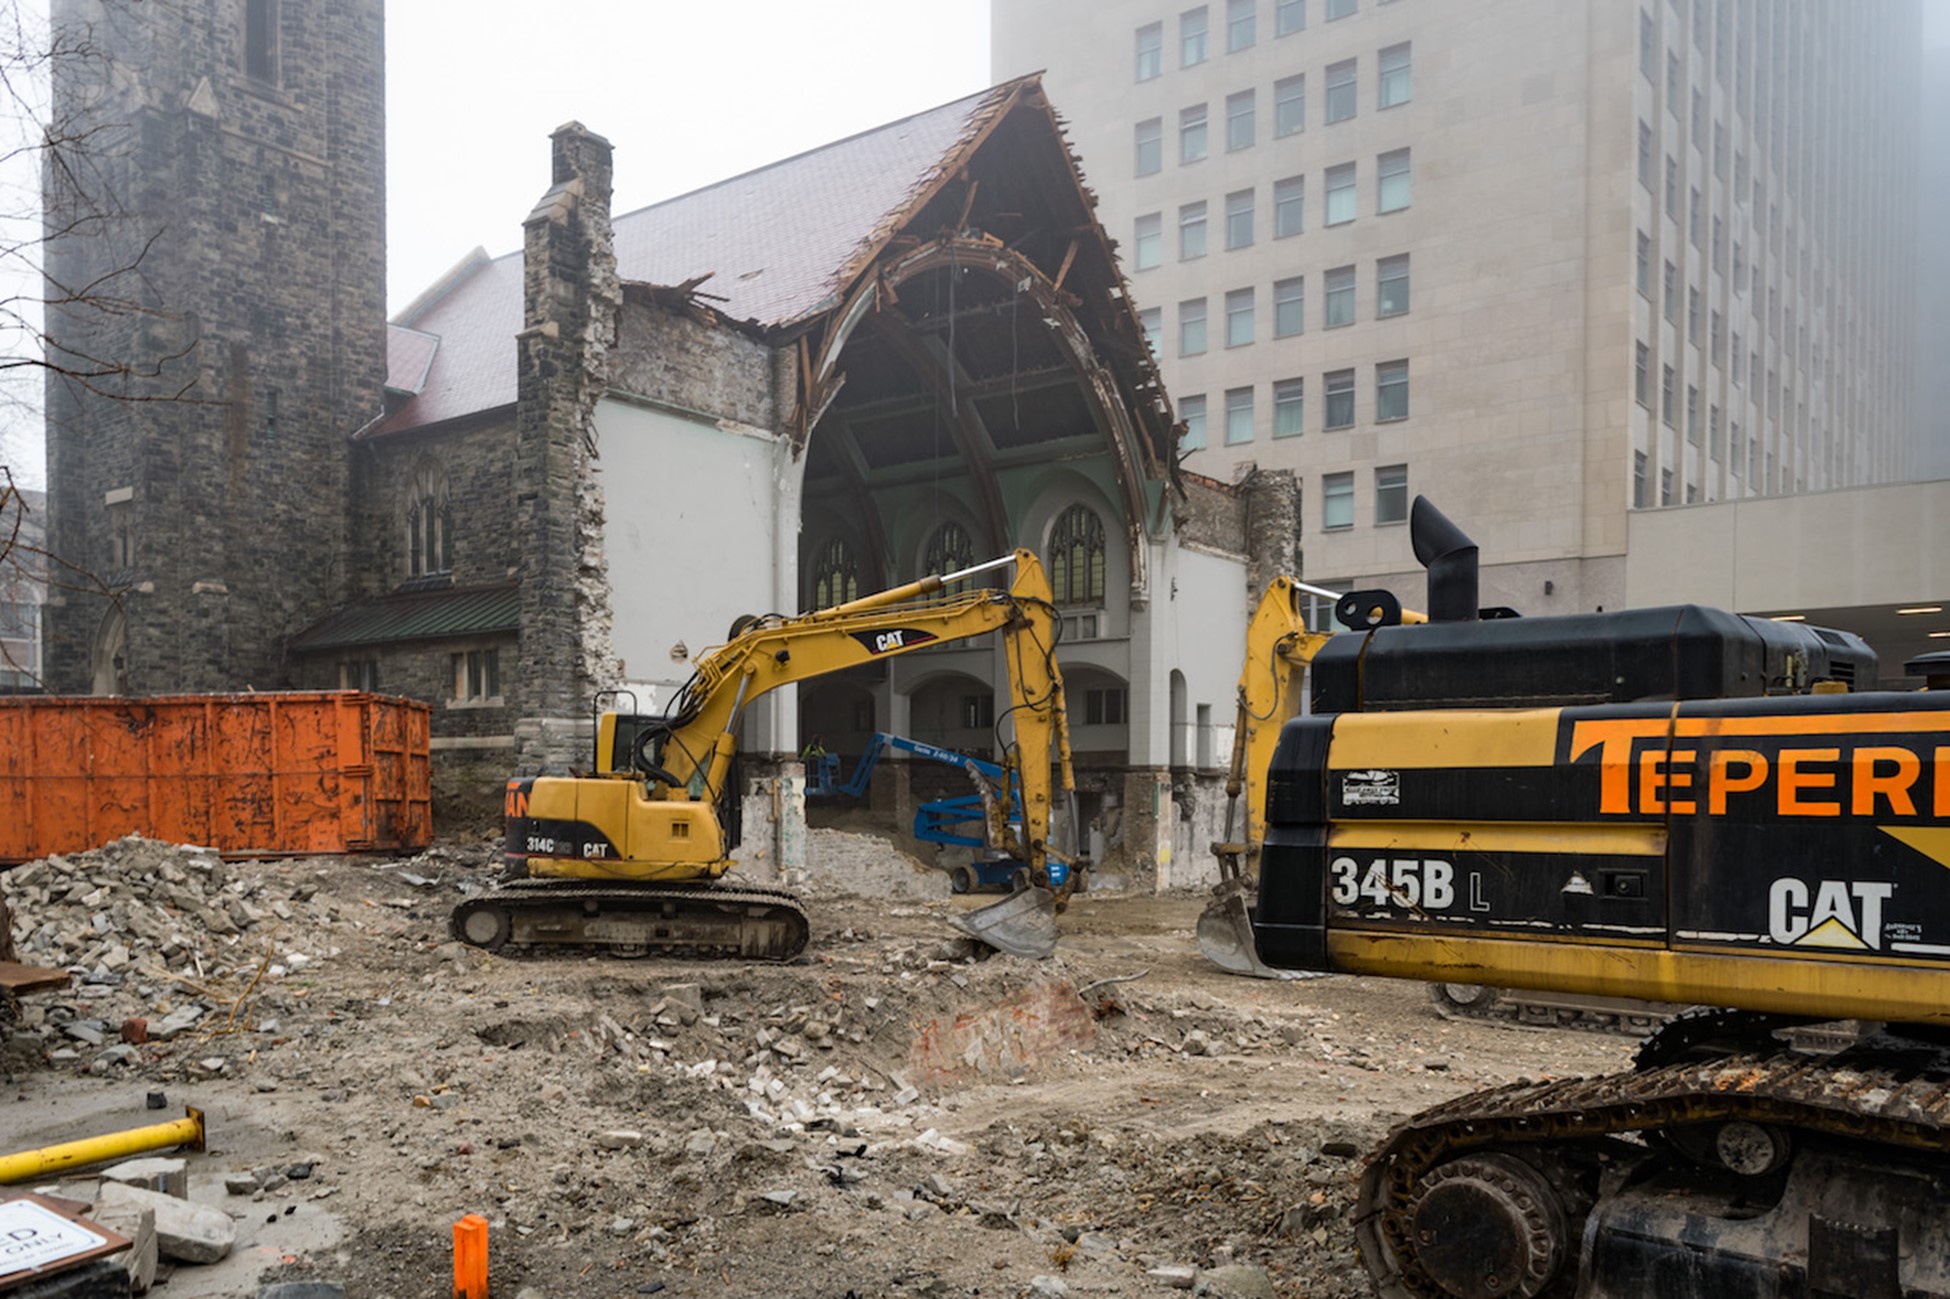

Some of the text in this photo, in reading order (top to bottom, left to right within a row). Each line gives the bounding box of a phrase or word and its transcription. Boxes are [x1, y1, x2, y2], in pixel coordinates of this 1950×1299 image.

[876, 630, 904, 652] CAT
[1570, 711, 1950, 816] TEPER
[504, 791, 531, 818] AN
[527, 836, 554, 853] 314C
[583, 842, 608, 858] CAT
[1331, 857, 1490, 912] 345B L
[1769, 877, 1893, 951] CAT
[5, 1232, 62, 1255] ONLY
